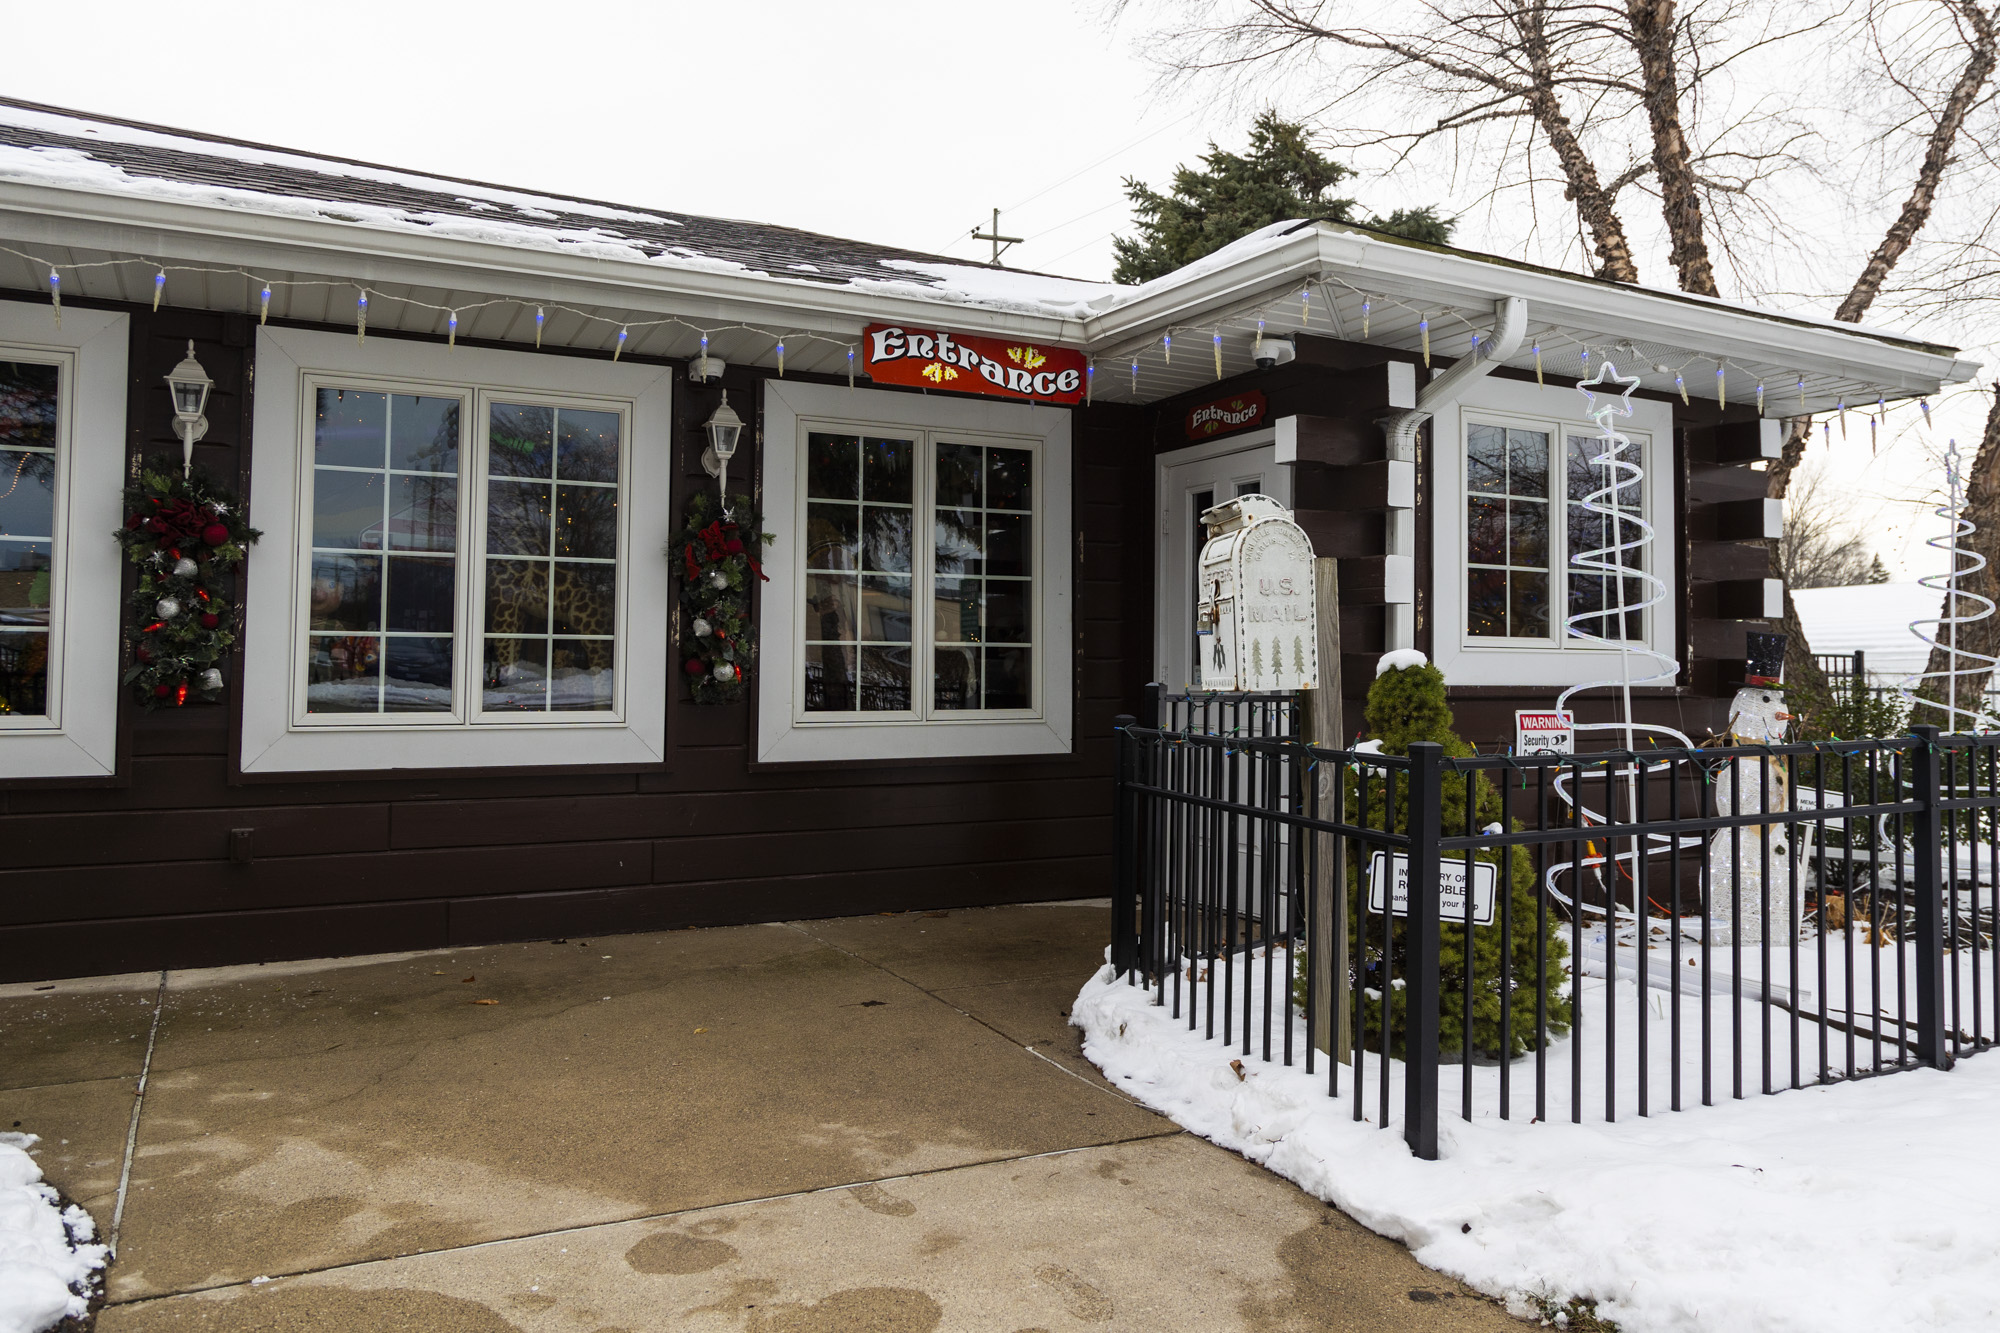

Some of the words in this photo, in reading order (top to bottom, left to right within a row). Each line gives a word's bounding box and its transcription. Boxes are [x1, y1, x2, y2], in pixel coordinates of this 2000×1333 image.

[871, 327, 1081, 396] Entrance
[1192, 404, 1257, 429] Entrance
[1259, 577, 1301, 596] U.S.
[1248, 603, 1308, 623] MAIL
[1524, 734, 1549, 748] Security
[1442, 900, 1459, 908] your
